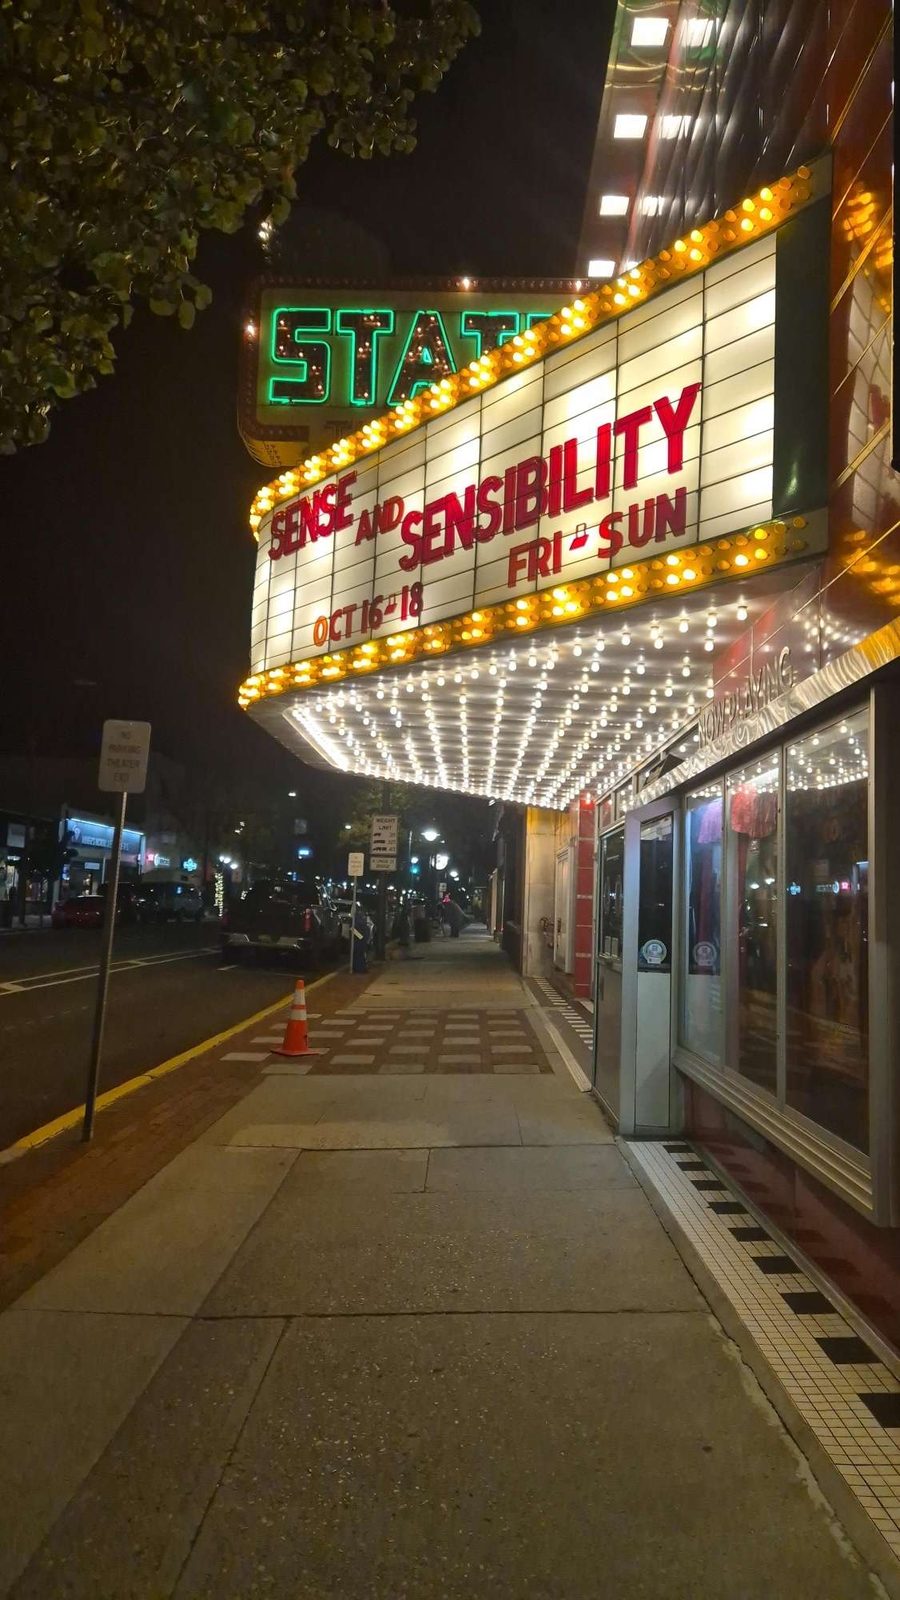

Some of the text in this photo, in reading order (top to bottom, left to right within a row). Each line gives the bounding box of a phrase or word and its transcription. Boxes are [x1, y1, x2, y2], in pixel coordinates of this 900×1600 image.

[269, 307, 553, 406] STAT
[268, 382, 702, 572] SENSE AND SENSIBILITY
[313, 603, 357, 647] OCT
